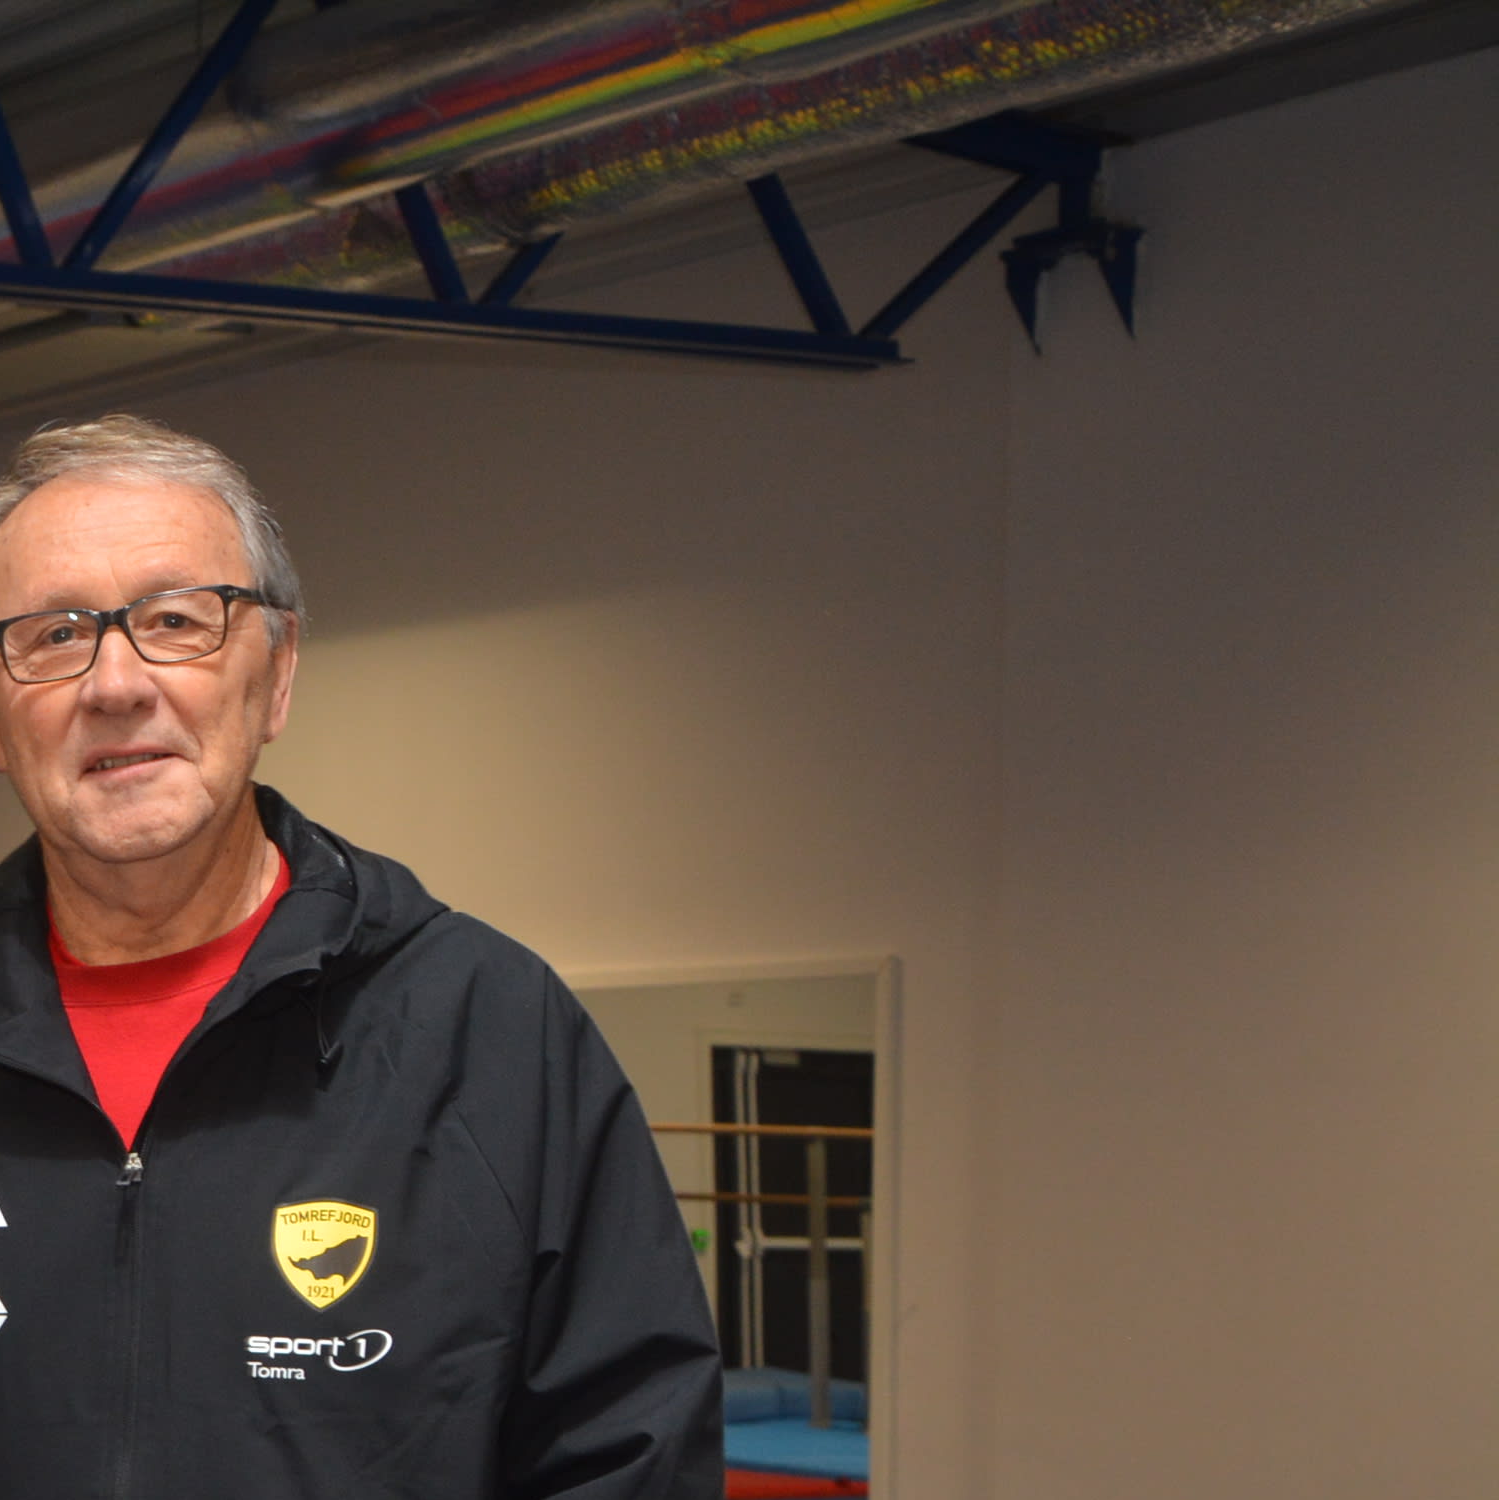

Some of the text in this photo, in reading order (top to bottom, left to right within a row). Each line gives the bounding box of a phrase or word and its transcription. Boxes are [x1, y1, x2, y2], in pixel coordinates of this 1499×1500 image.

[280, 1209, 371, 1229] TOMREFJORD
[307, 1285, 335, 1299] 1921
[247, 1336, 345, 1358] sport
[247, 1362, 306, 1380] Tomra
